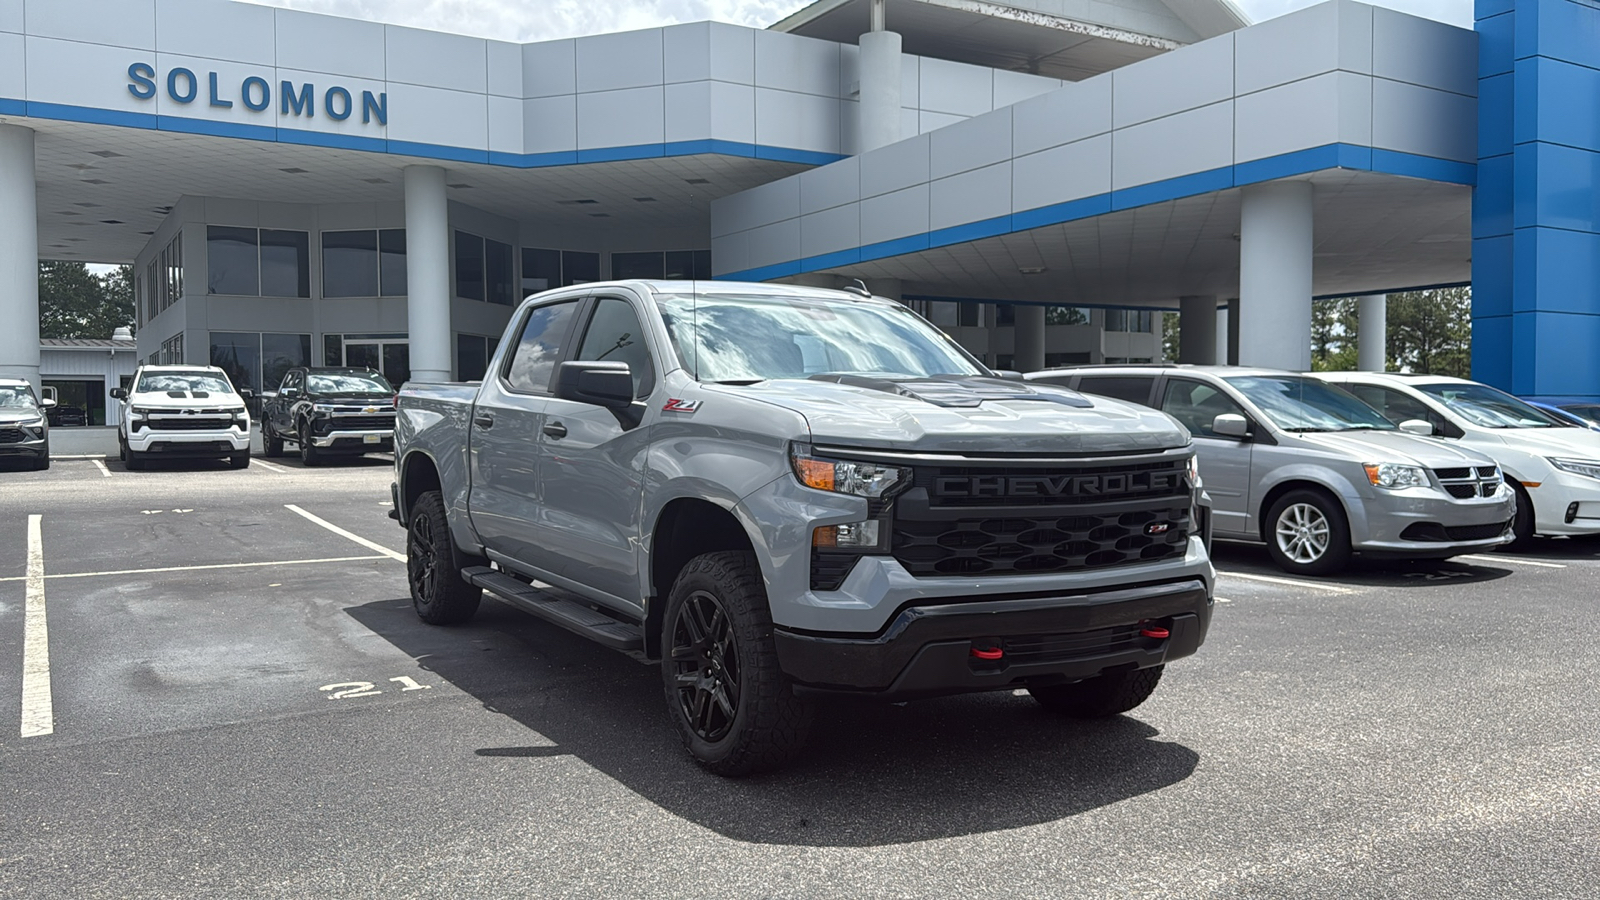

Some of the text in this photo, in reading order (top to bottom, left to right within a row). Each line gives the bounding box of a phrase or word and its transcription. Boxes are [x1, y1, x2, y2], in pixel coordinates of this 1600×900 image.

[127, 62, 388, 125] SOLOMON
[662, 397, 703, 413] Z71
[936, 470, 1186, 496] CHEVROLET
